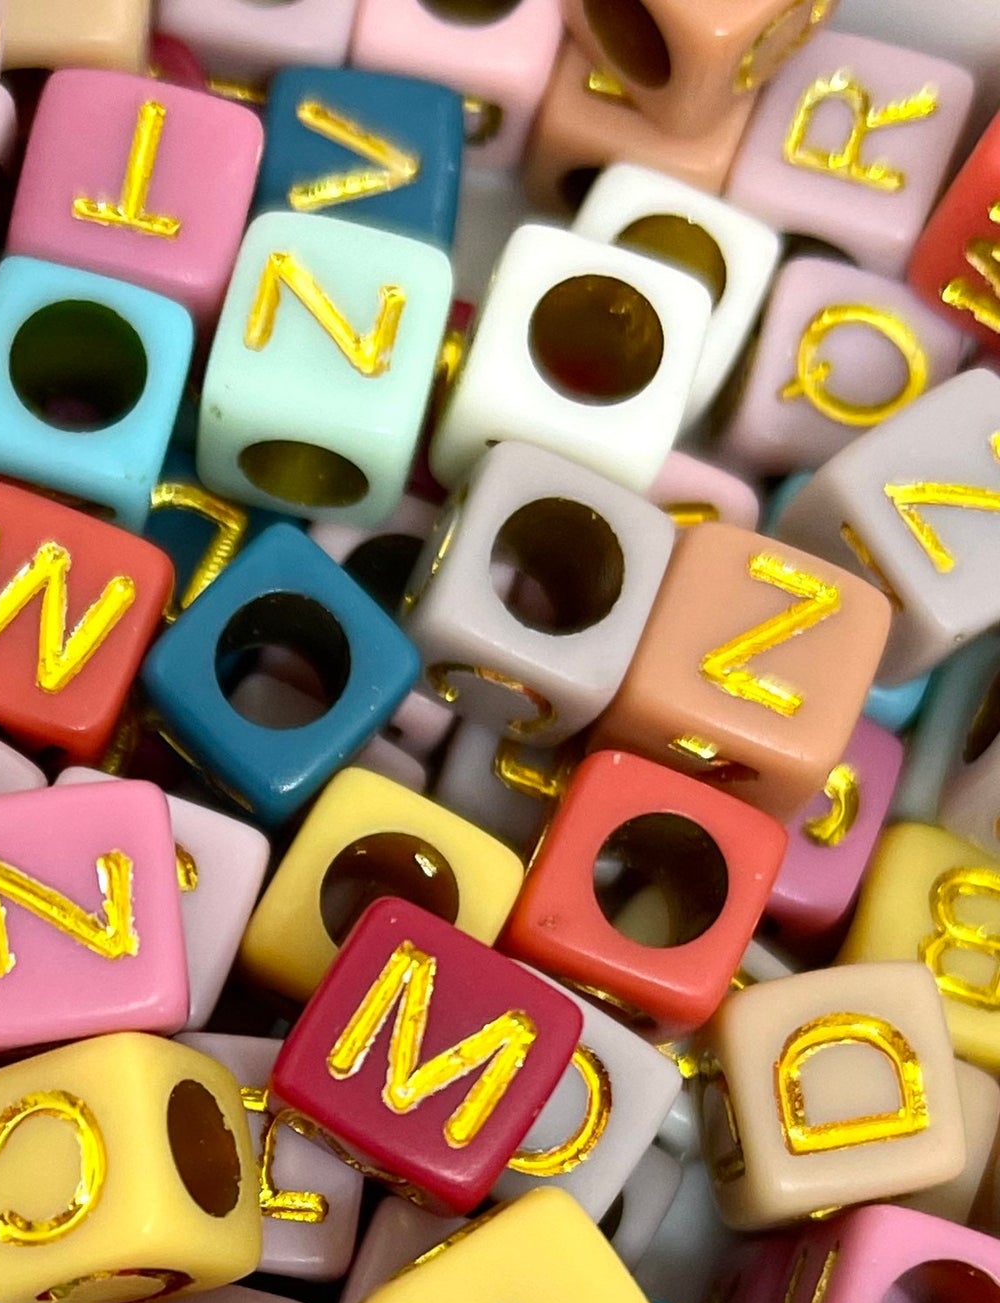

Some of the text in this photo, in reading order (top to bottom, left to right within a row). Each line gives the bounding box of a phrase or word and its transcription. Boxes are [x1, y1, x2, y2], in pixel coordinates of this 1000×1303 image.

[72, 99, 182, 240] T
[289, 99, 420, 212] V
[783, 66, 939, 193] R
[779, 303, 928, 427] Q
[326, 939, 538, 1149] M
[772, 1011, 930, 1156] D
